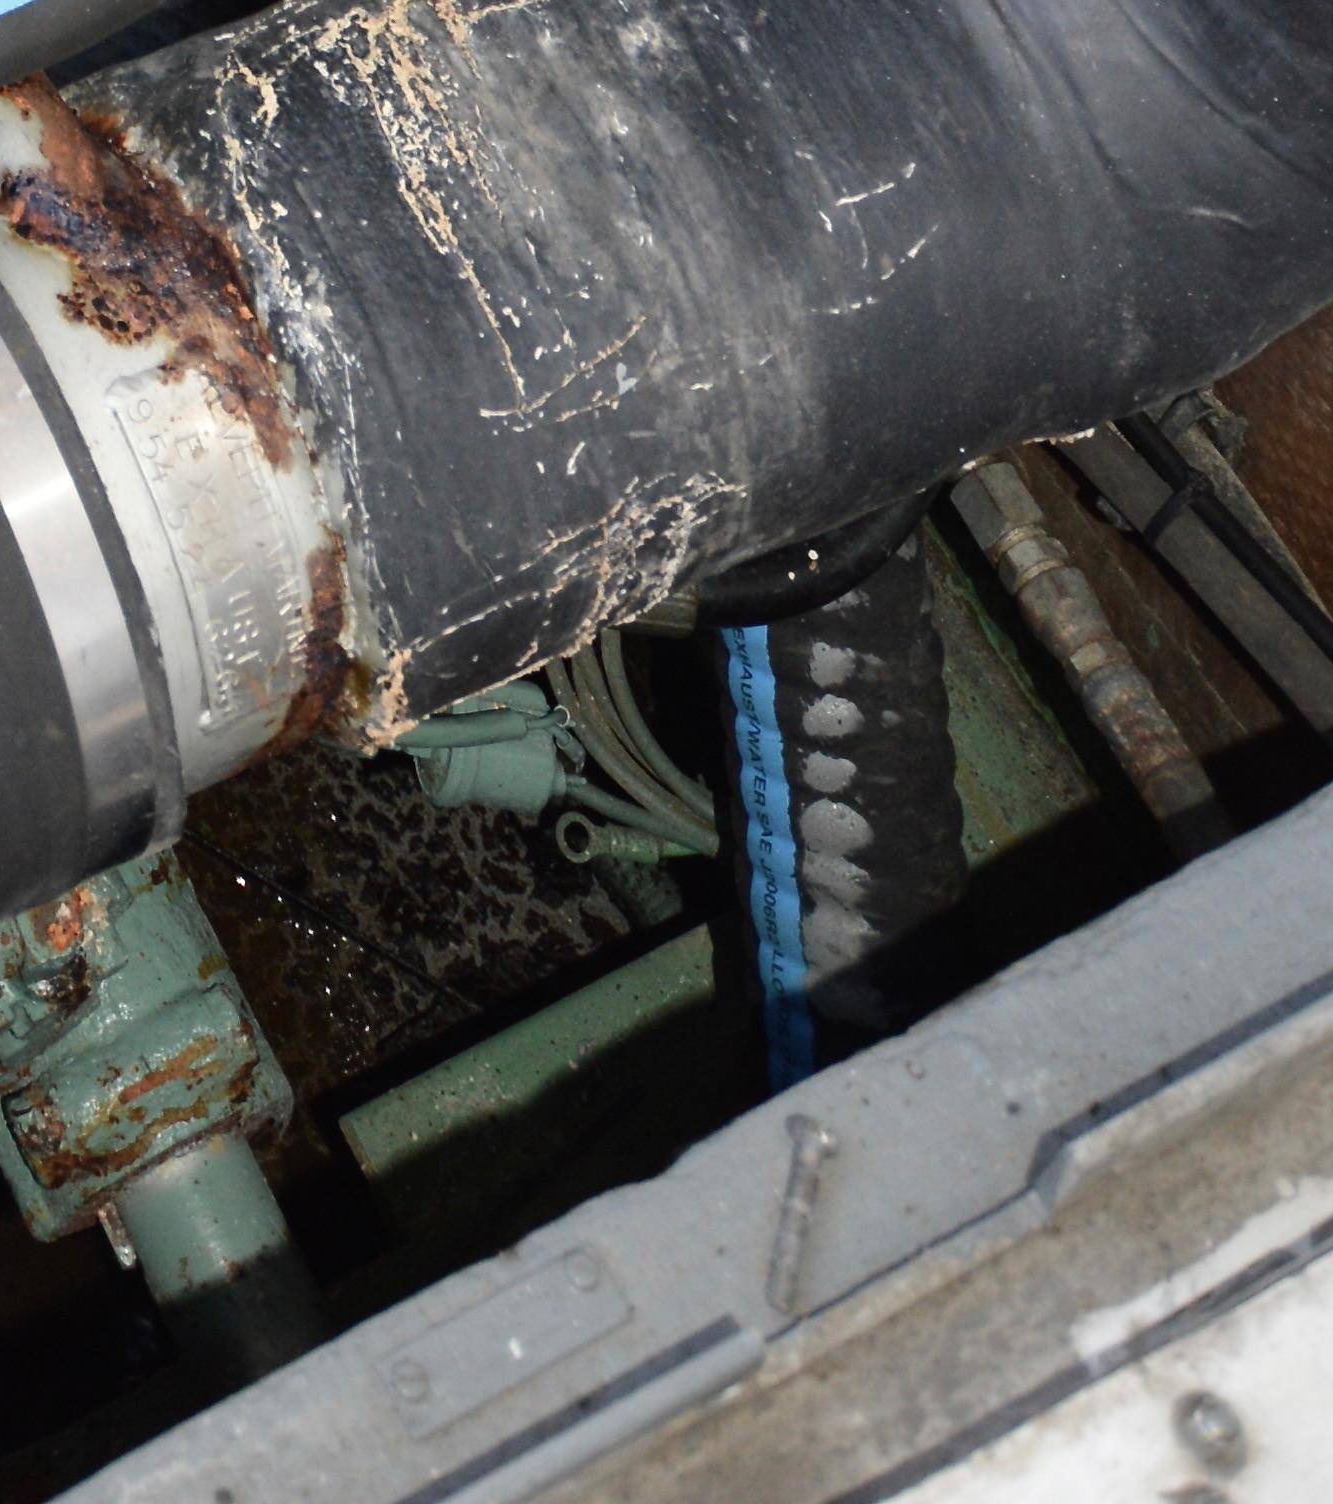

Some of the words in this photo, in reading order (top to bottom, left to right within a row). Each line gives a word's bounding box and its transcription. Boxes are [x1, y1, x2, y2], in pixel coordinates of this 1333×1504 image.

[126, 398, 175, 484] 954
[175, 432, 261, 665] EXHAUST
[733, 628, 768, 807] EXHAUST/WATER
[756, 811, 774, 855] SAE
